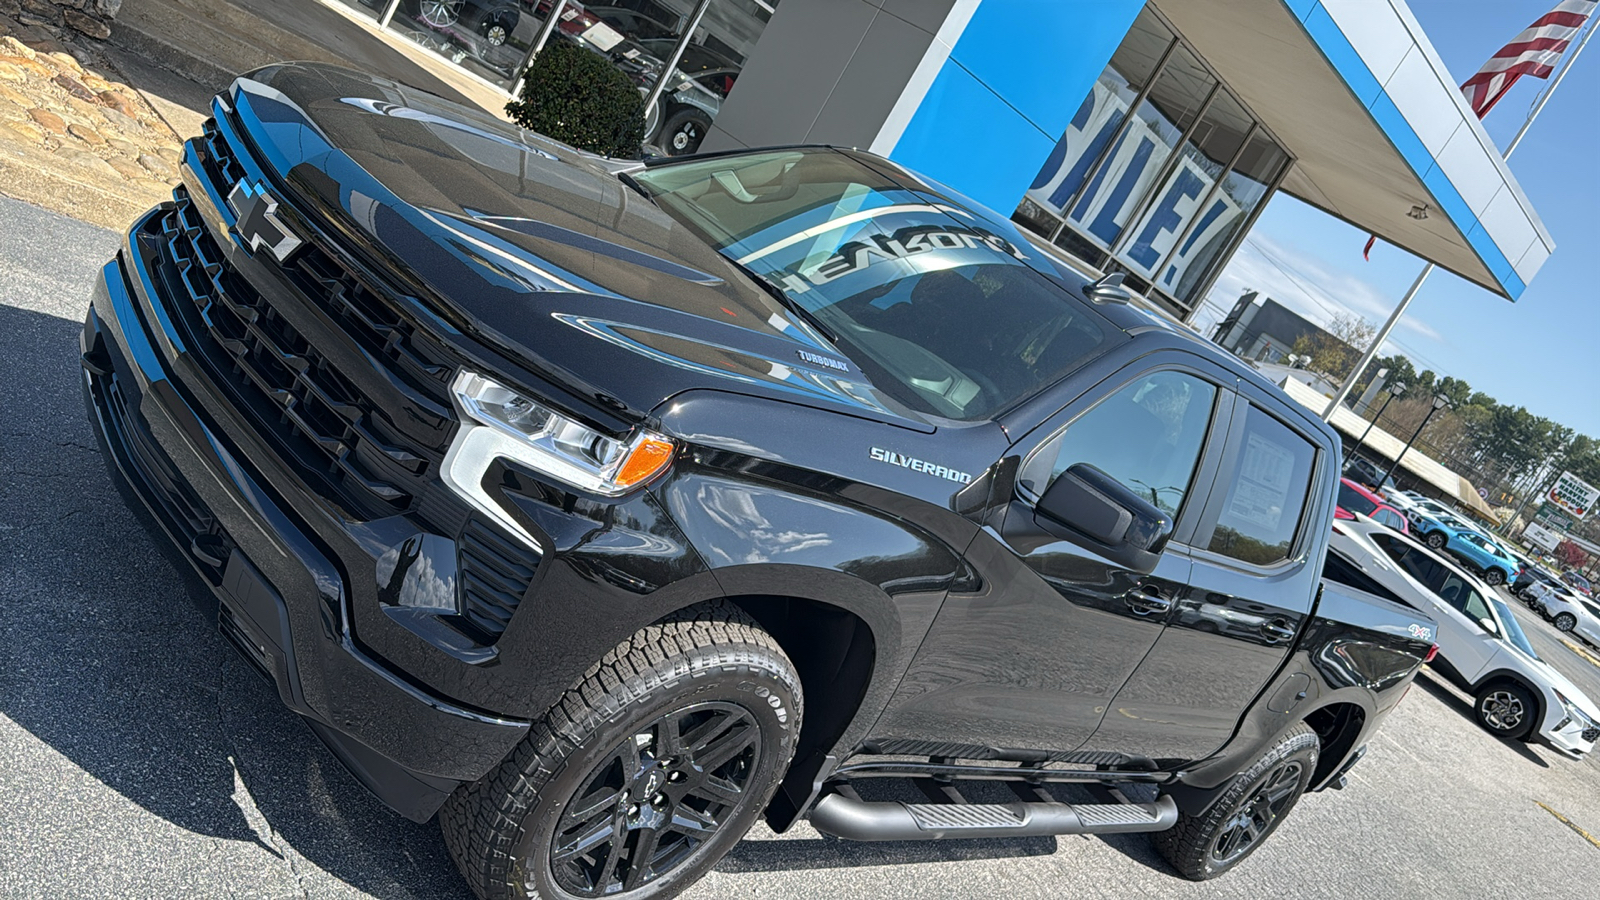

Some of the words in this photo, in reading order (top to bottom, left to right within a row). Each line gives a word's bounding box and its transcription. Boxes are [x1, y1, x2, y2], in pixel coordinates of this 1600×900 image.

[798, 349, 850, 372] TURBOMAX
[869, 446, 972, 485] SILVERADO
[1558, 484, 1590, 505] HARVEST
[1559, 477, 1590, 497] HEALTHY
[1556, 490, 1589, 512] PRODUCE
